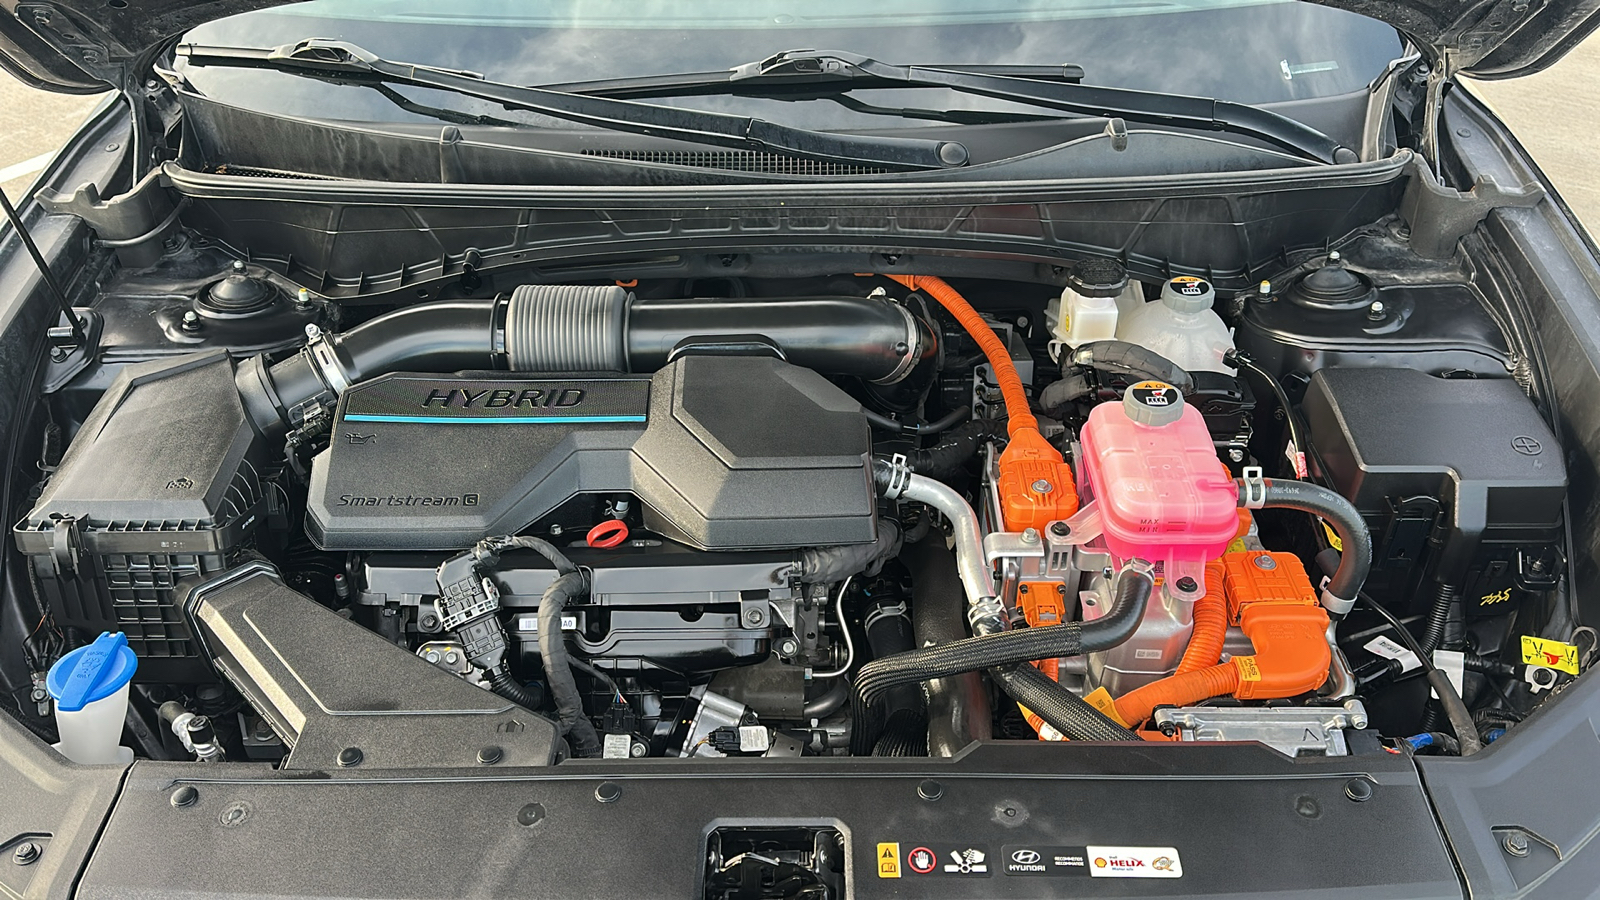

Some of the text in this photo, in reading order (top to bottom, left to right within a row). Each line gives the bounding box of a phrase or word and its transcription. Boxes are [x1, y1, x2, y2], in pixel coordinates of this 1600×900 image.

[421, 388, 586, 409] HYBRID
[337, 493, 460, 507] Smartstream
[1009, 864, 1046, 872] HYUNDAI
